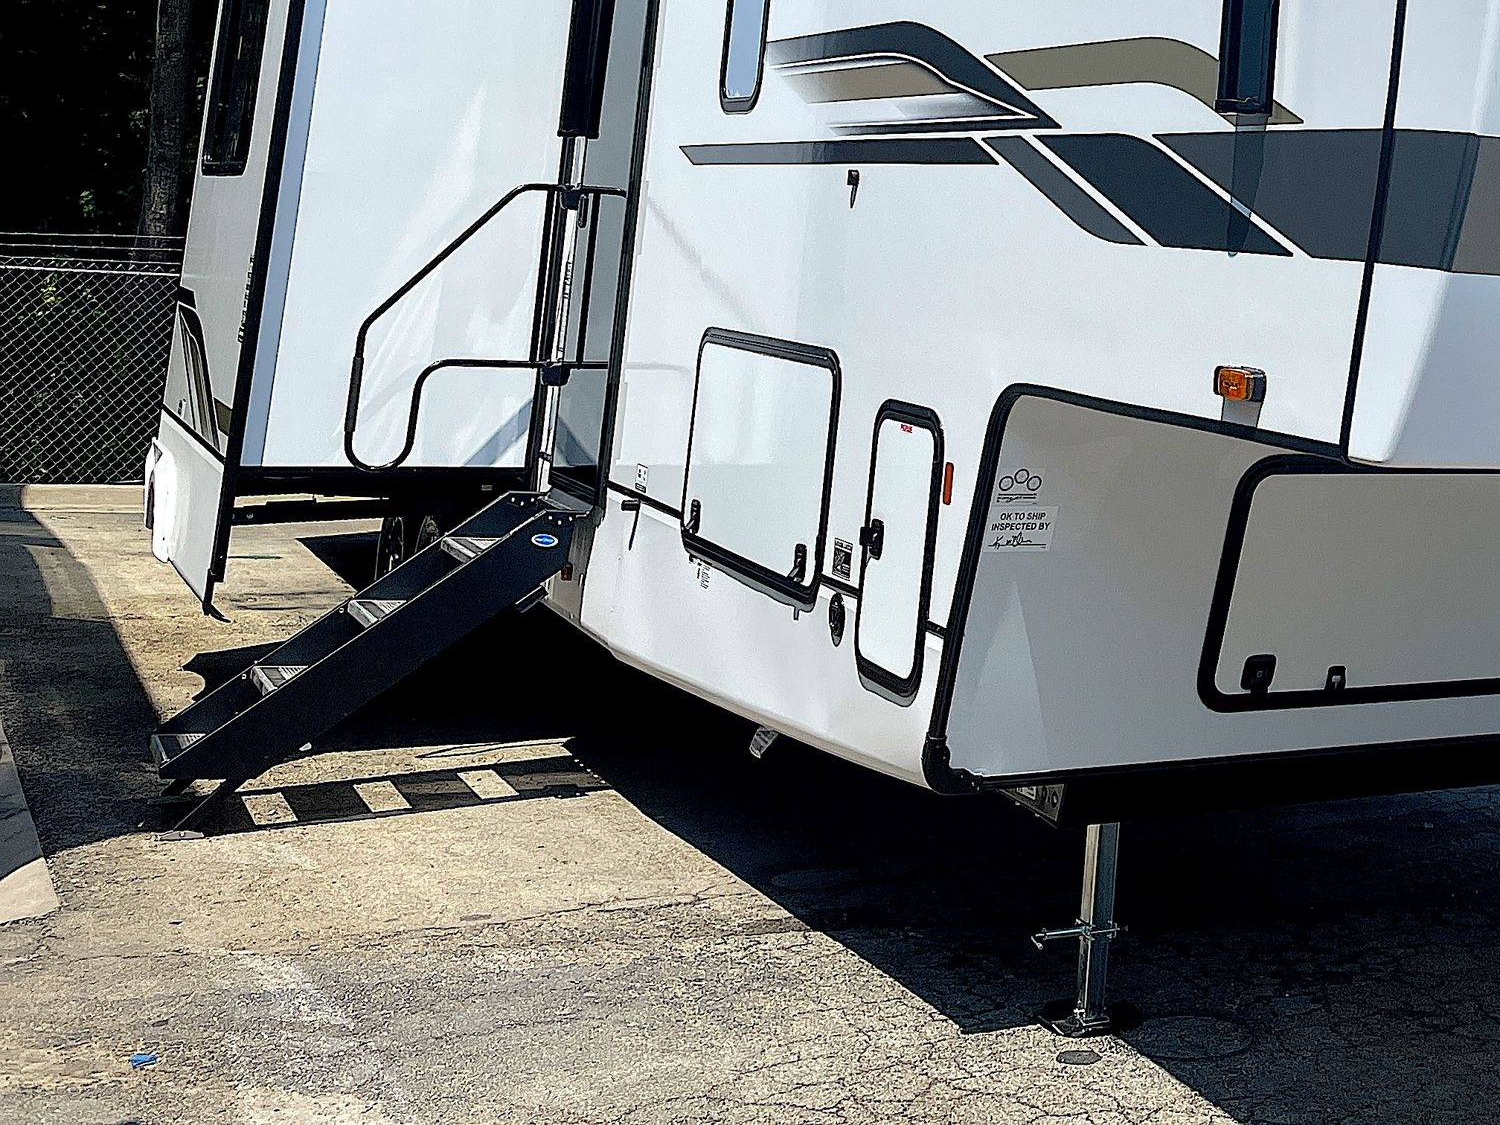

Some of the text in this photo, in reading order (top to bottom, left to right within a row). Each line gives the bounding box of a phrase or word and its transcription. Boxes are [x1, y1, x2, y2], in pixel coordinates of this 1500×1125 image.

[1000, 512, 1047, 521] OK TO SHIP
[991, 522, 1051, 531] INSPECTED BY
